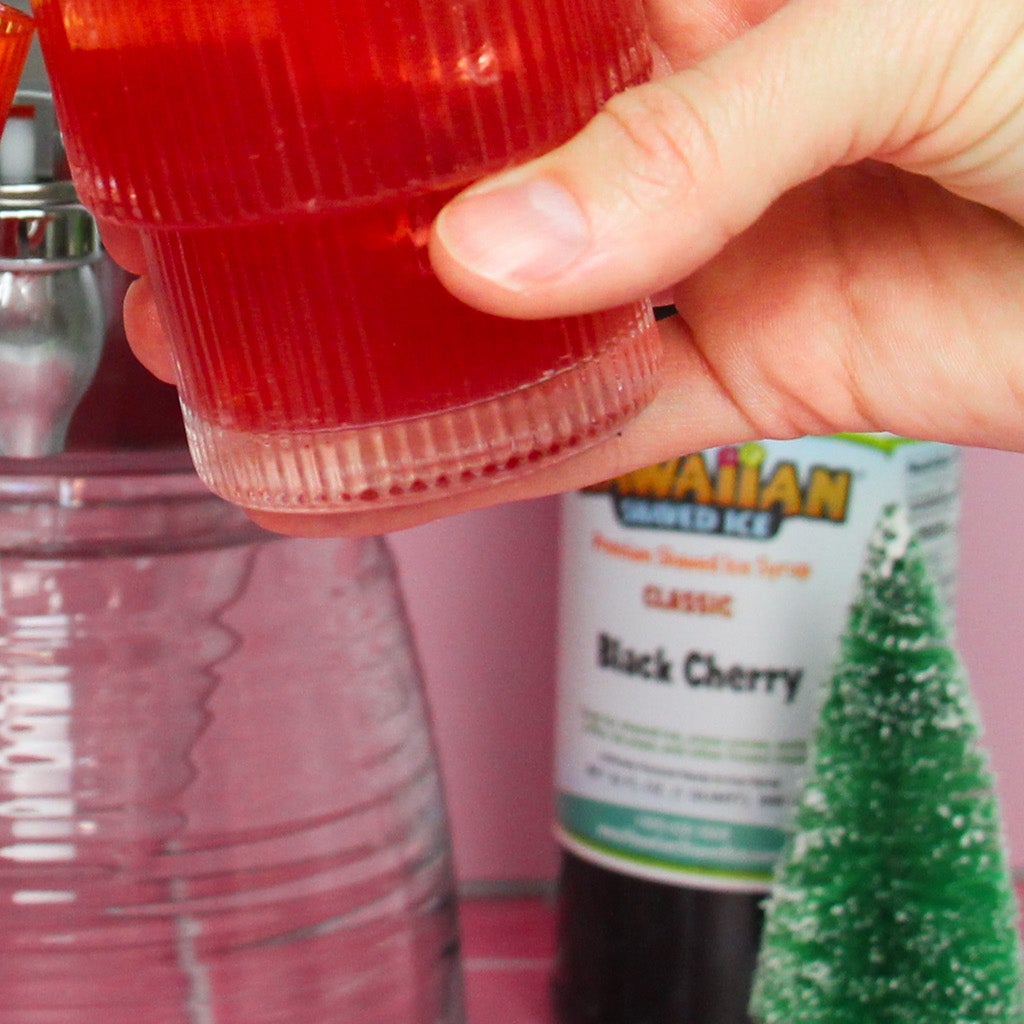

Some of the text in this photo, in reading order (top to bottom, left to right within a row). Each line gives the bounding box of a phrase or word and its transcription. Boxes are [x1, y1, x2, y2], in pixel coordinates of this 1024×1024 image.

[642, 584, 734, 618] CLASSIC
[597, 631, 804, 705] Black Cherry
